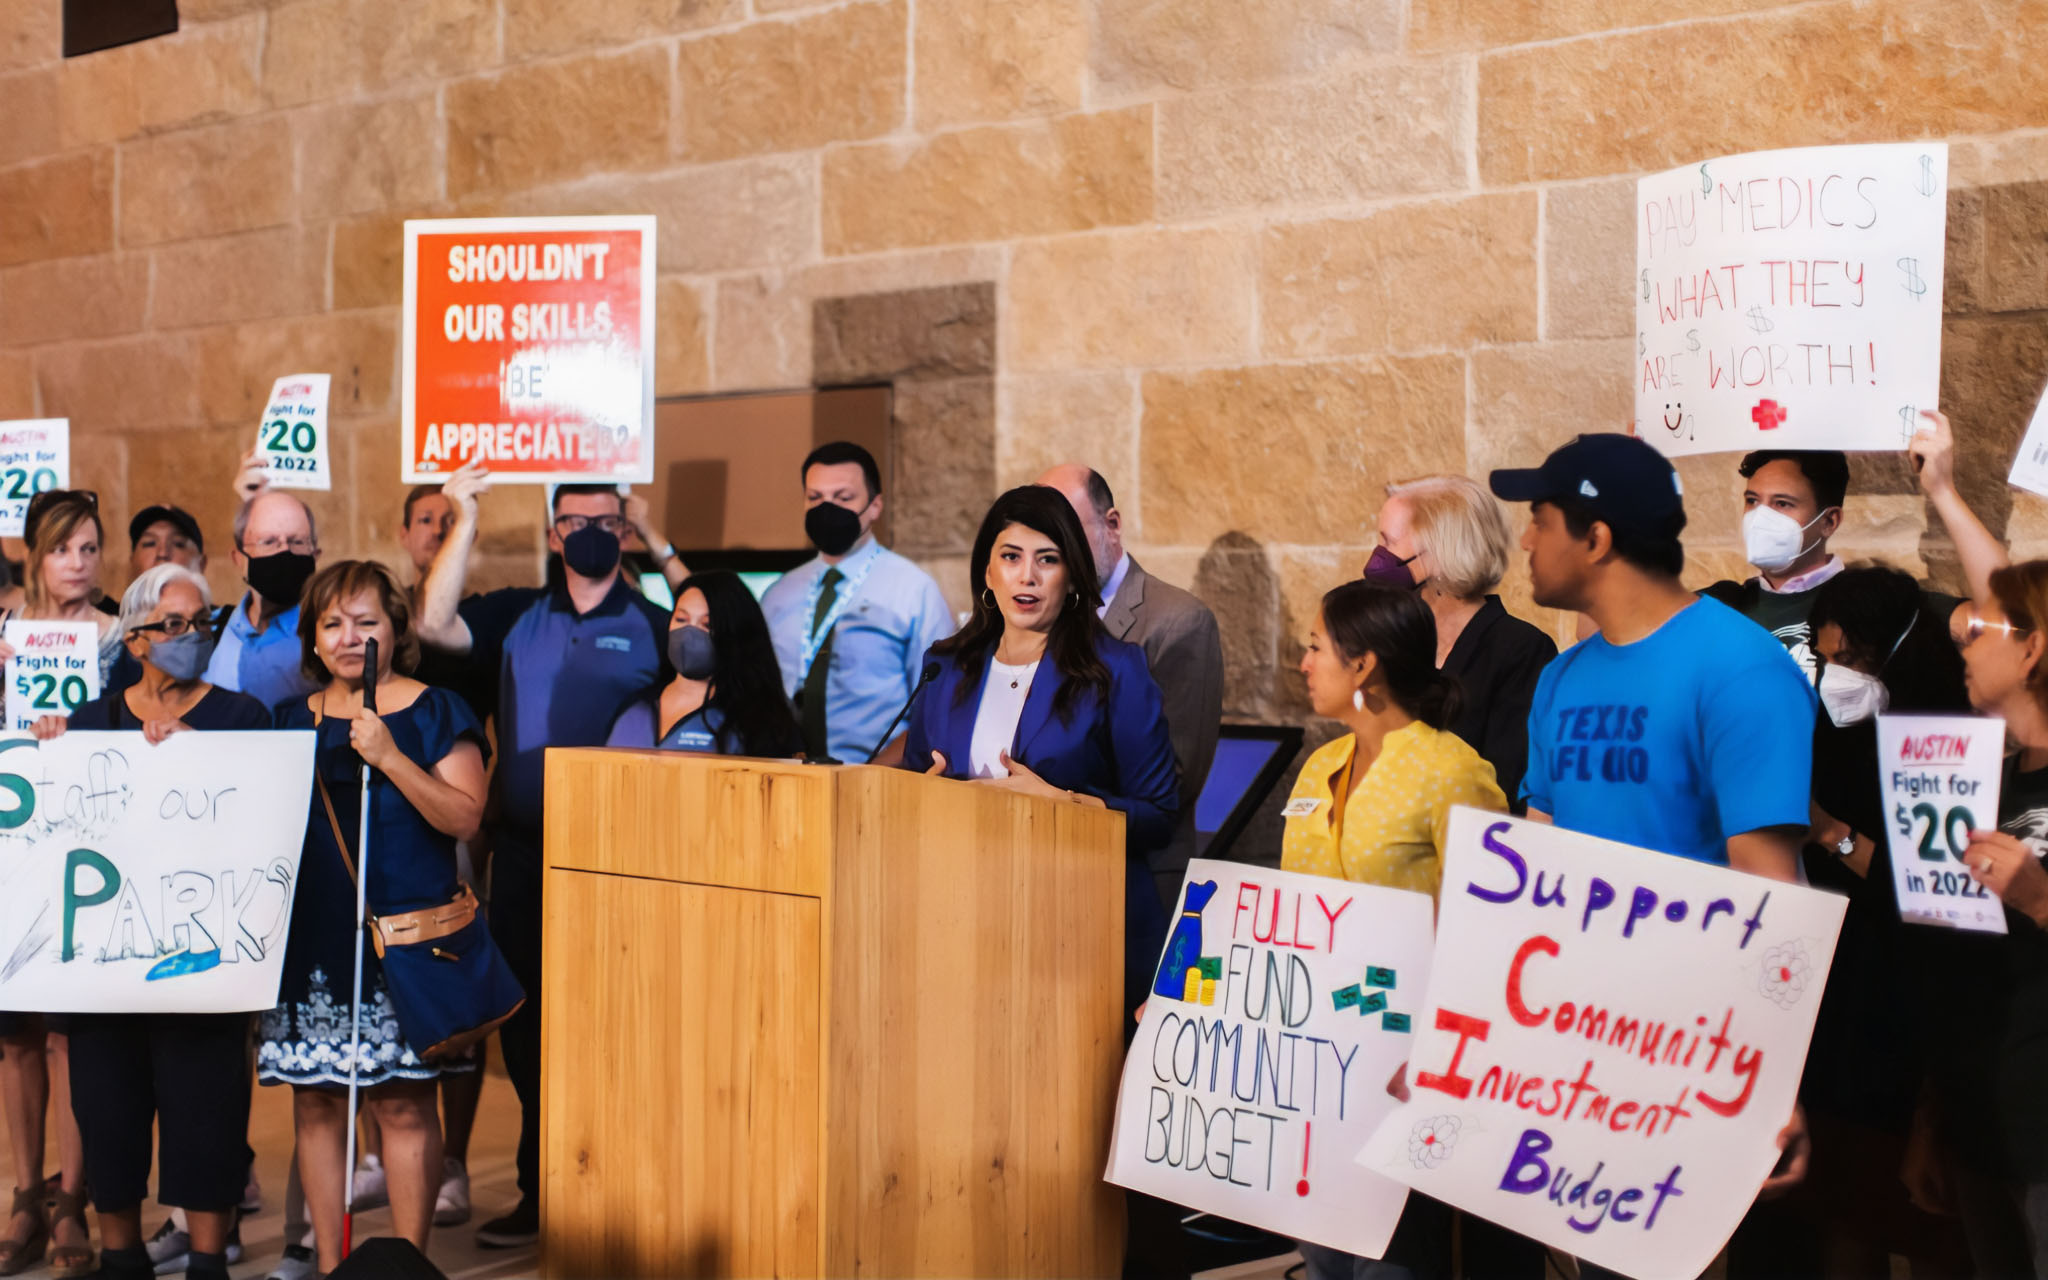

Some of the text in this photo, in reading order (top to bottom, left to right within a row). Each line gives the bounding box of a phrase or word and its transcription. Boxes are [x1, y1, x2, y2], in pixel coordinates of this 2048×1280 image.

[1646, 174, 1877, 259] PAY MEDICS
[448, 243, 609, 283] SHOULDN'T
[1656, 260, 1864, 325] WHAT THEY
[444, 301, 613, 342] OUR SKILLS
[1643, 352, 1684, 393] ARE
[269, 404, 293, 416] ight
[273, 456, 317, 473] 2022
[25, 632, 78, 648] AUSTIN
[16, 655, 86, 670] Fight for
[16, 673, 88, 710] $20
[1900, 734, 1972, 761] AUSTIN
[1892, 771, 1981, 798] Fight for
[159, 787, 238, 824] our
[1895, 801, 1978, 866] $20
[1466, 821, 1772, 950] Support
[1906, 868, 1925, 893] in
[1232, 881, 1354, 954] FULLY
[1223, 943, 1313, 1029] FUND
[1505, 935, 1765, 1118] Community
[1152, 1011, 1360, 1121] COMMUNITY
[1414, 1007, 1693, 1138] Investment
[1498, 1128, 1685, 1234] Budget
